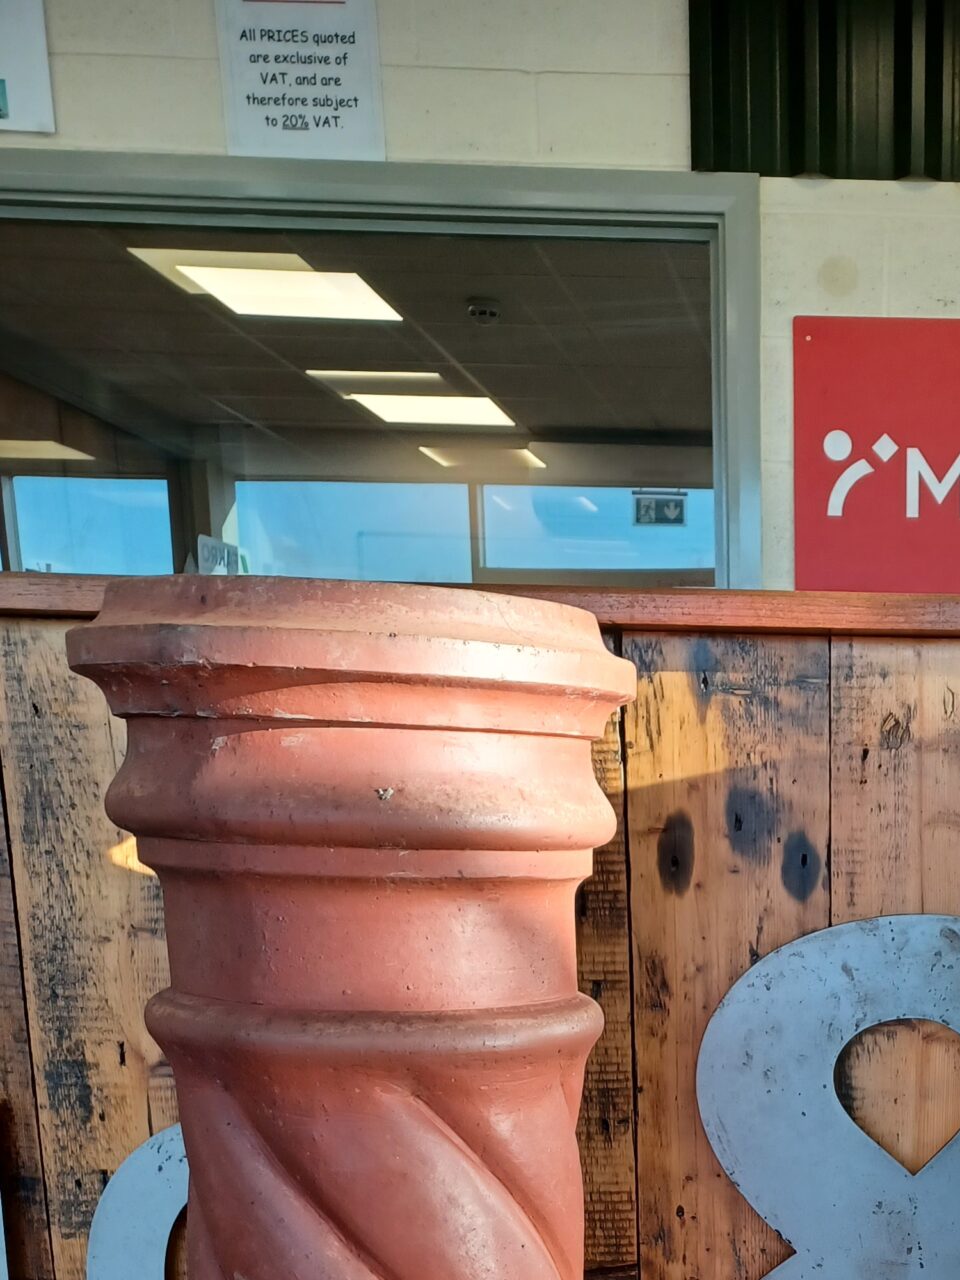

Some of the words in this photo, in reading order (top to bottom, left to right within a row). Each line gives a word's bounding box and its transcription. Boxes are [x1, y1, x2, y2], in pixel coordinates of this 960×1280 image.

[239, 29, 256, 43] All
[260, 29, 309, 43] PRICES
[312, 31, 356, 46] quoted
[249, 53, 271, 64] are
[274, 51, 331, 65] exclusive
[335, 52, 349, 66] of
[260, 72, 292, 87] VAT,
[295, 73, 317, 86] and
[320, 76, 342, 87] are
[246, 92, 309, 107] therefore
[312, 94, 359, 111] subject
[265, 115, 278, 128] to
[282, 113, 310, 130] 20%
[313, 115, 344, 129] VAT.
